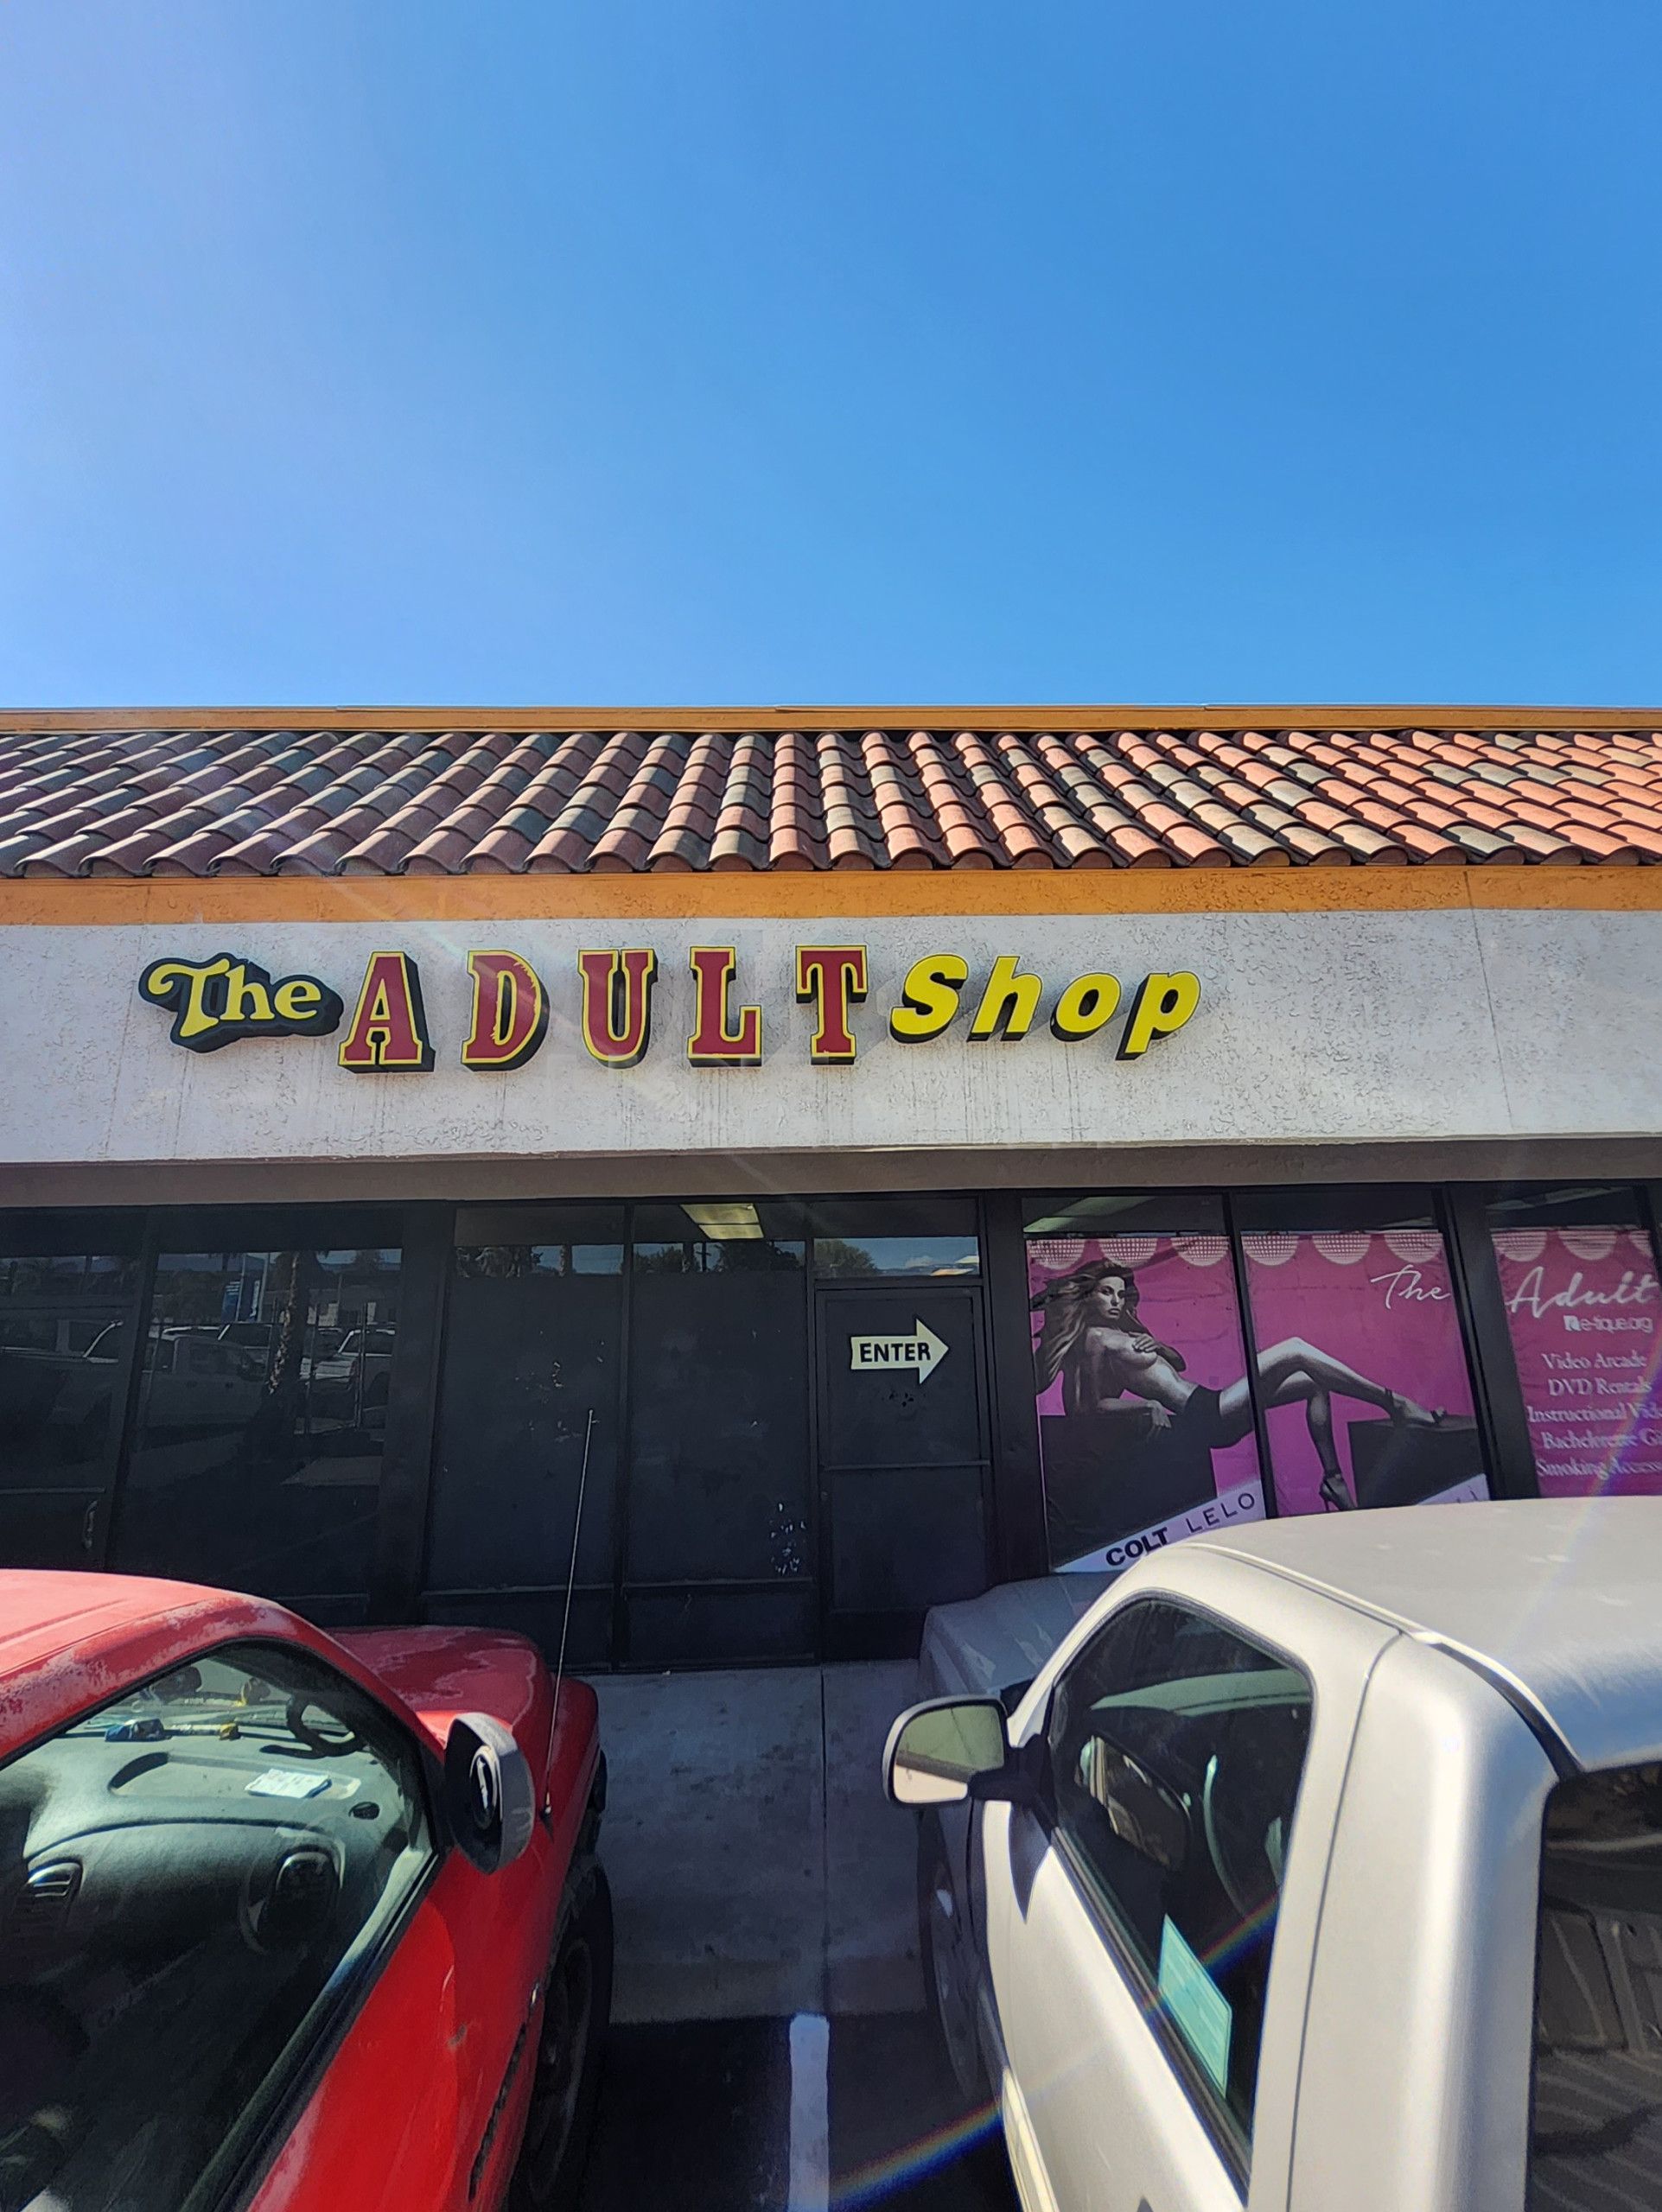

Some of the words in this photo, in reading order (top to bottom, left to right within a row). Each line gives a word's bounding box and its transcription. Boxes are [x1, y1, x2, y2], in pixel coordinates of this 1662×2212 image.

[143, 953, 335, 1047] The
[336, 944, 869, 1074] ADULT
[889, 953, 1202, 1061] Shop
[1371, 1264, 1451, 1310] The
[1505, 1266, 1660, 1319] Adult
[859, 1342, 931, 1363] ENTER
[1541, 1351, 1591, 1370] Video
[1594, 1350, 1647, 1369] Arcade
[1548, 1377, 1593, 1396] DVD
[1105, 1526, 1168, 1567] COLT
[1185, 1492, 1255, 1534] LELO
